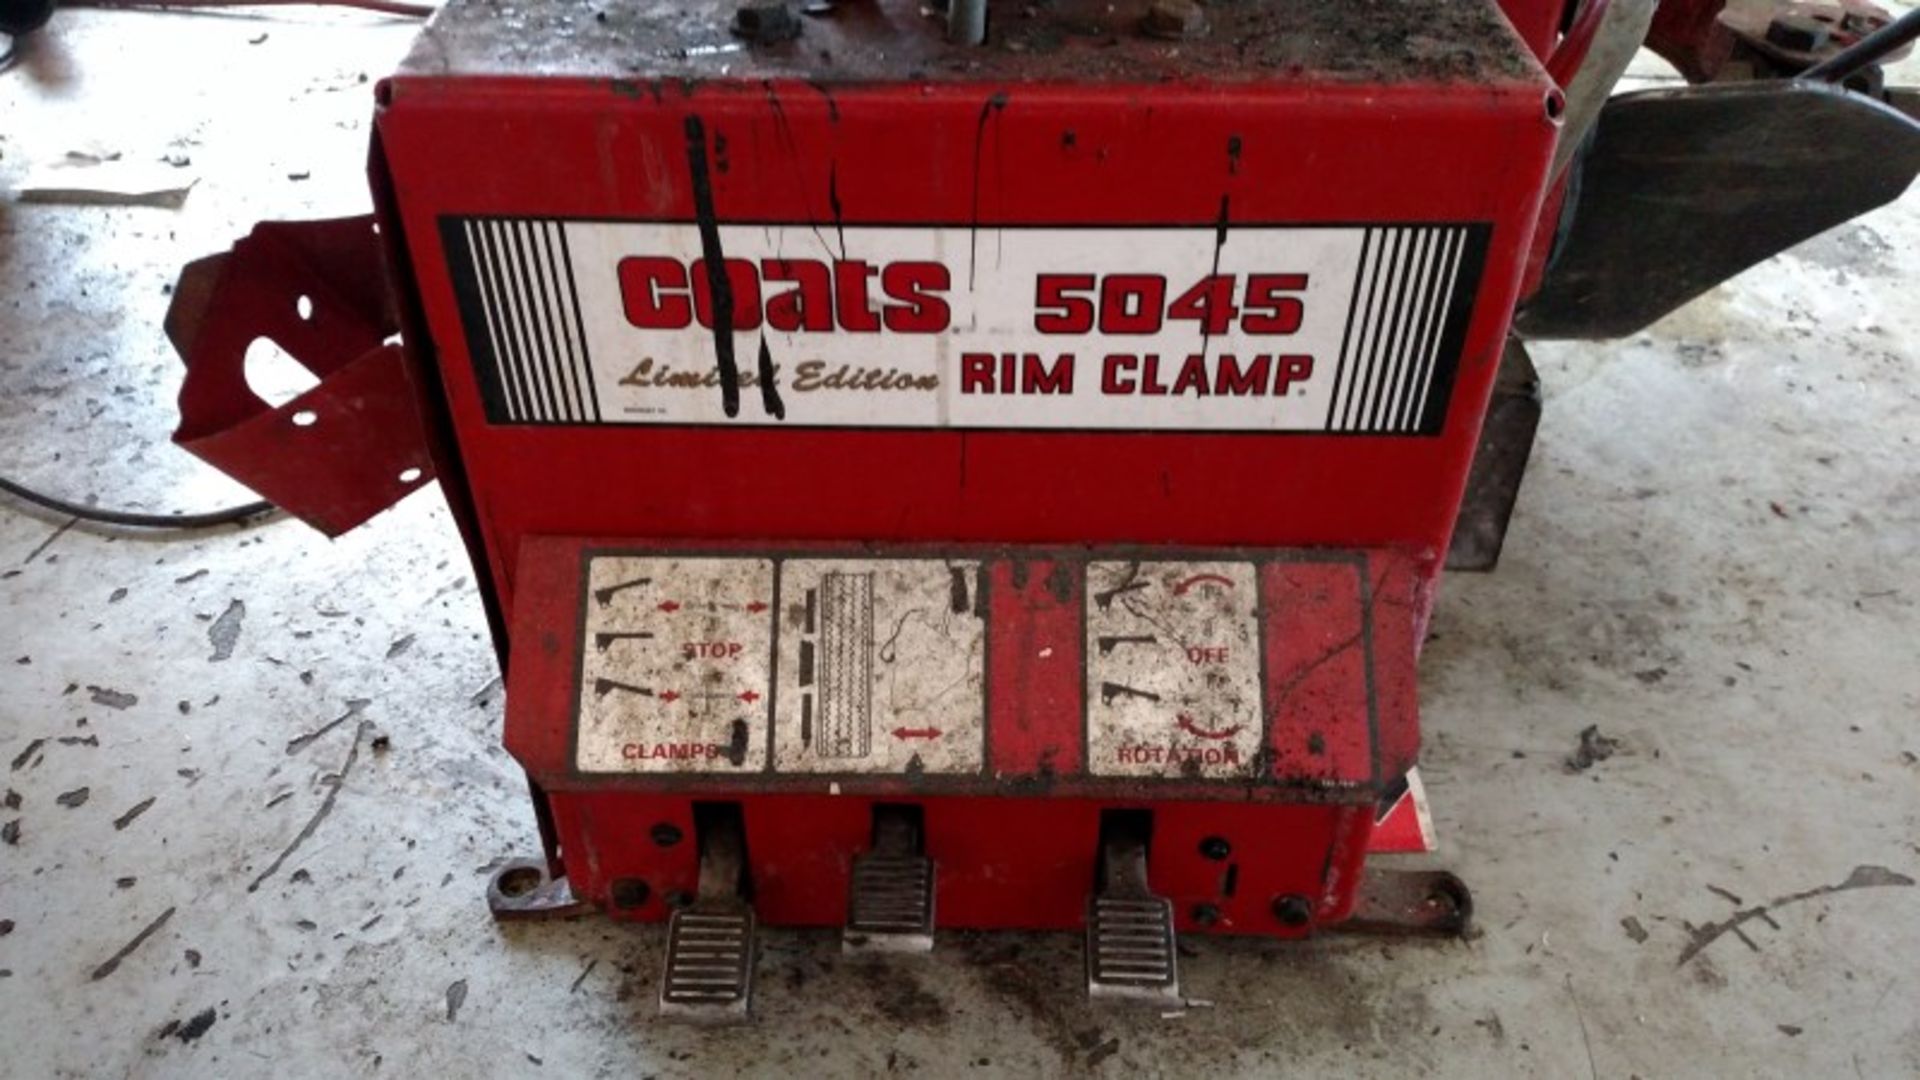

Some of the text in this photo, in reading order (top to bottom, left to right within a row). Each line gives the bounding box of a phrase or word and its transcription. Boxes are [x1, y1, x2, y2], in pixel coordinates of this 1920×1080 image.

[1034, 272, 1309, 336] 5045
[792, 360, 939, 392] Edition
[961, 353, 1314, 396] RIM CLAMP
[683, 642, 742, 659] STOP
[622, 743, 719, 760] CLAMPS
